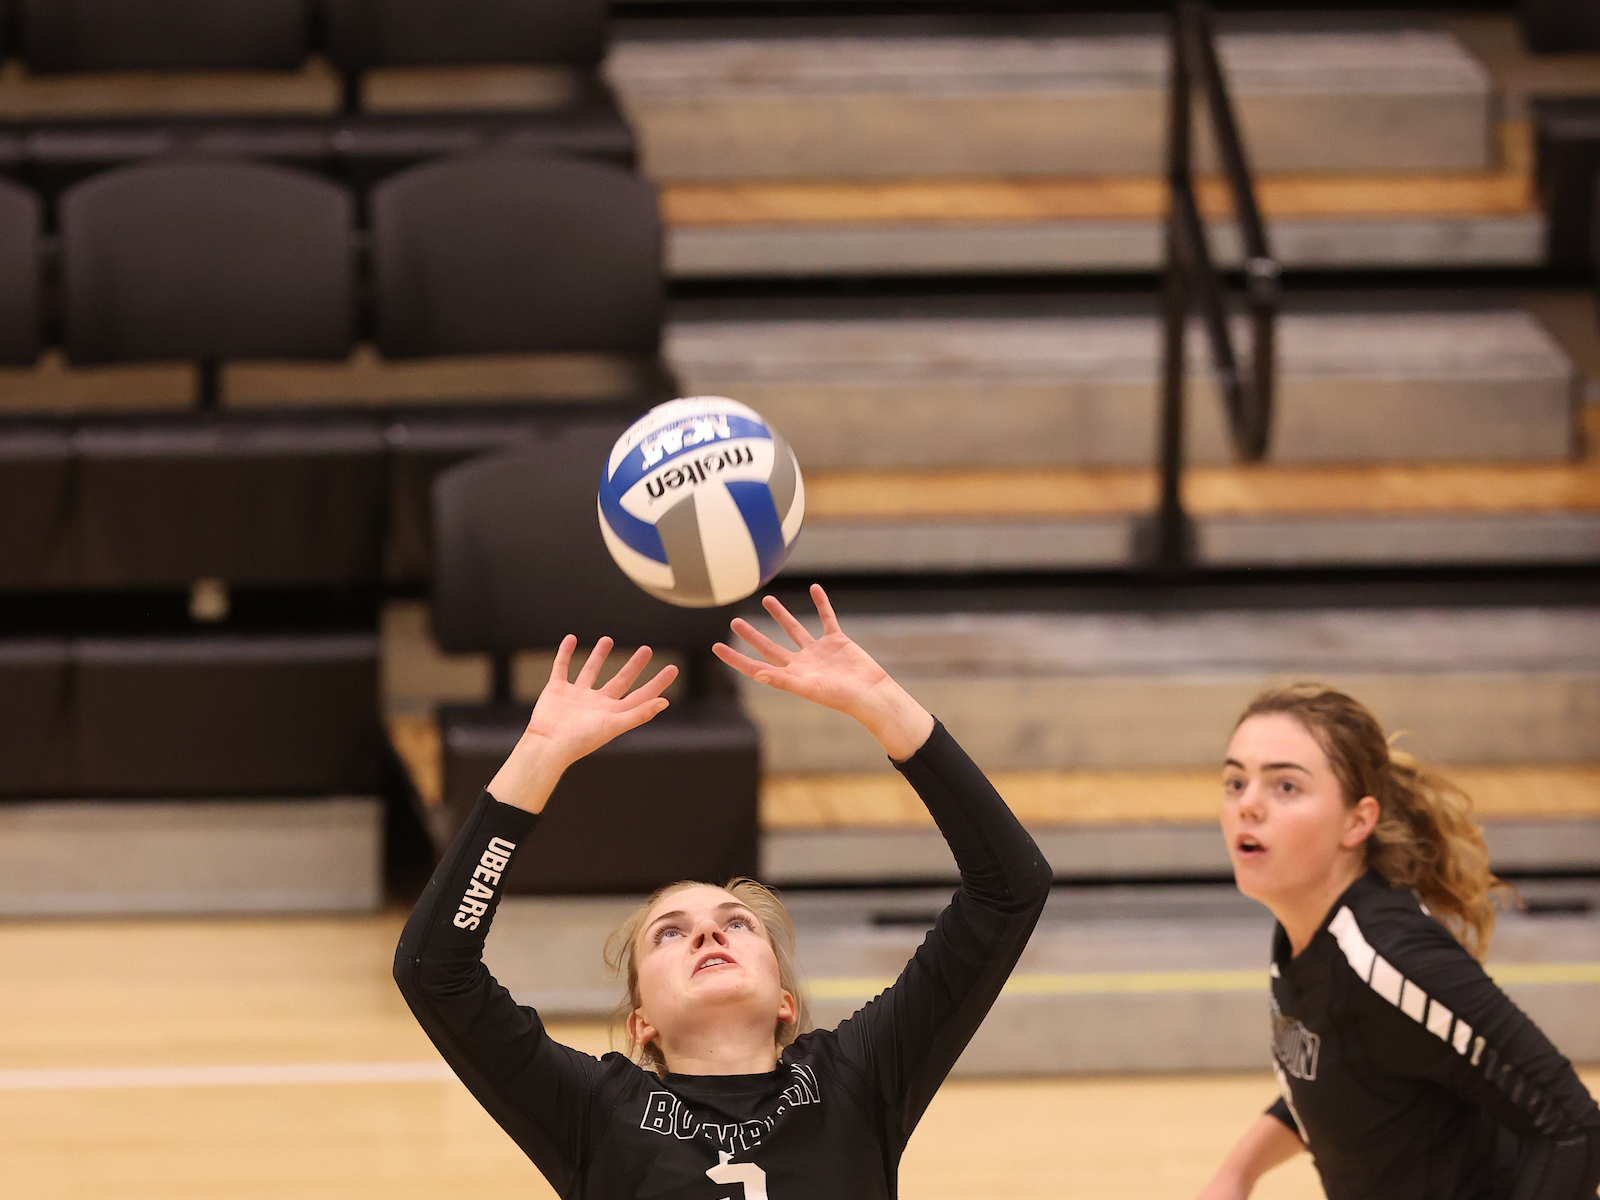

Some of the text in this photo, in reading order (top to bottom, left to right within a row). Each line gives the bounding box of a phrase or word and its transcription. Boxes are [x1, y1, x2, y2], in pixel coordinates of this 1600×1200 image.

[640, 413, 731, 471] NCAA
[646, 445, 753, 498] molten
[453, 836, 517, 931] UBEARS
